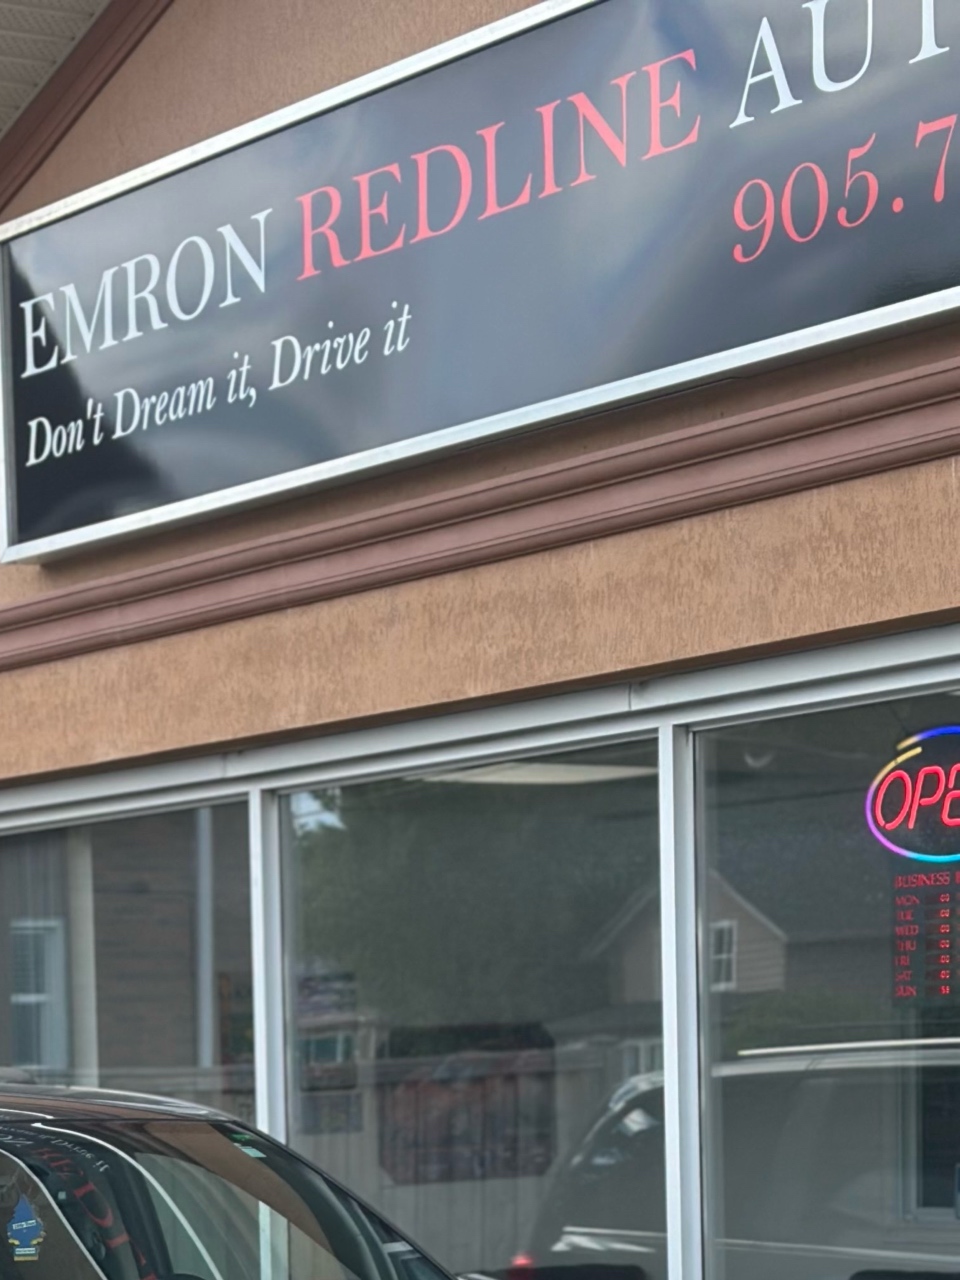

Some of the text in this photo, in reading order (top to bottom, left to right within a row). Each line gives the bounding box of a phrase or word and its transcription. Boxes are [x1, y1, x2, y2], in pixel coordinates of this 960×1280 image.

[19, 207, 273, 378] EMRON
[295, 50, 702, 281] REDLINE
[732, 113, 958, 263] 905.7
[25, 300, 412, 467] Don't Dream it, Drive it
[895, 871, 951, 888] BUSINESS
